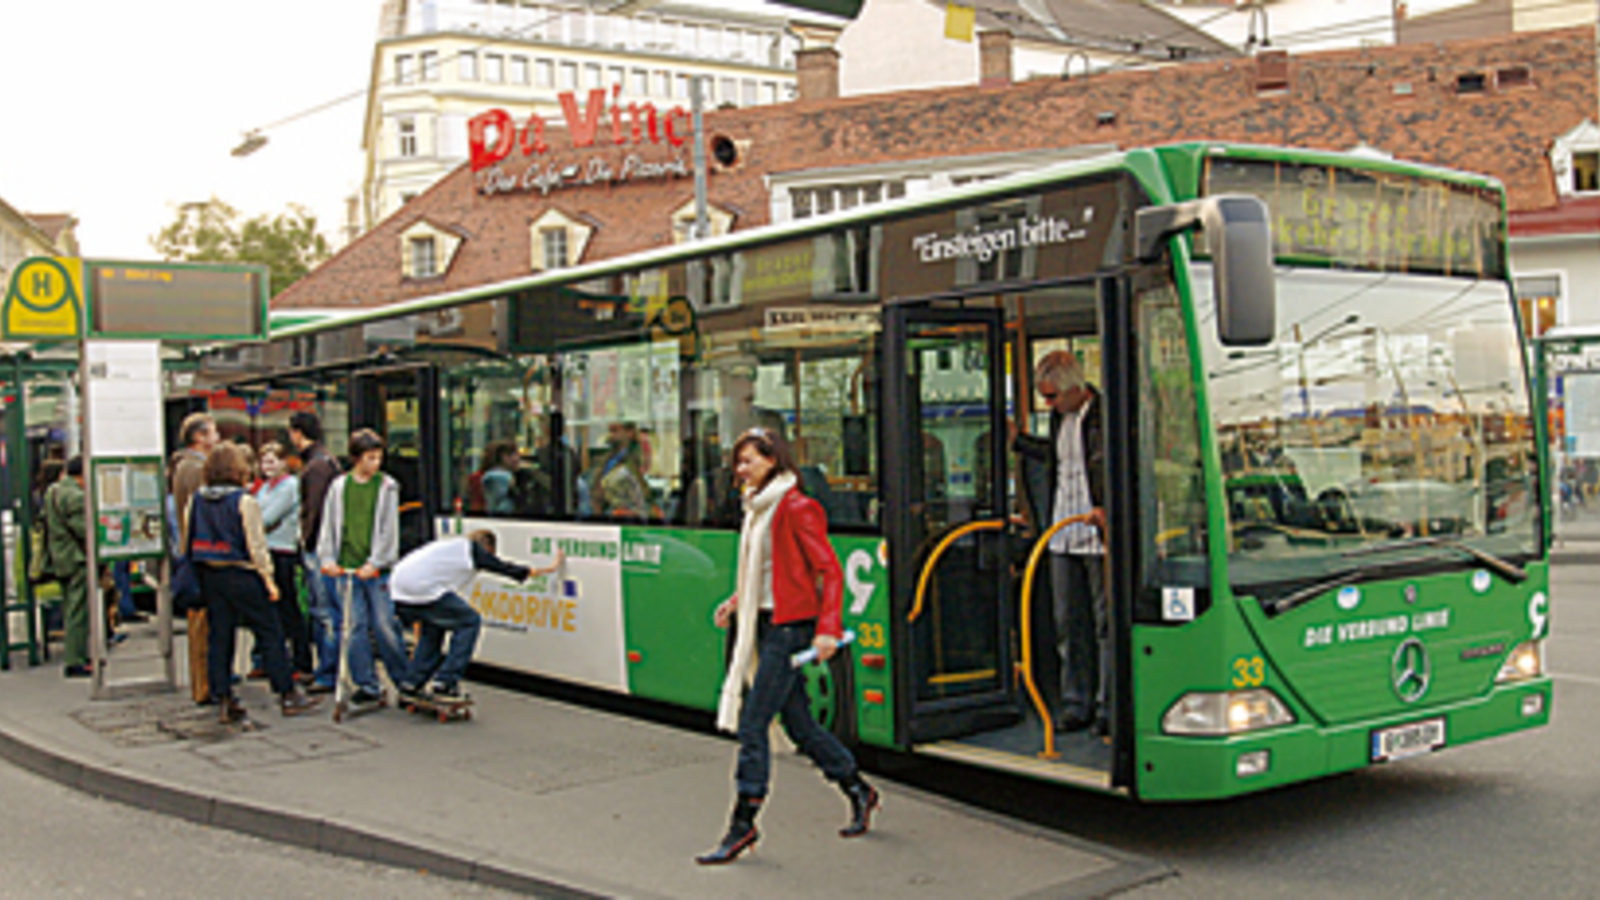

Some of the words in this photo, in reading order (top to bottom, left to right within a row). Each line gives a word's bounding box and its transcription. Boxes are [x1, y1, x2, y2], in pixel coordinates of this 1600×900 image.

[467, 108, 549, 172] Da
[557, 83, 695, 148] Vinc
[32, 271, 53, 297] H
[530, 536, 552, 555] DIE
[556, 537, 618, 561] VERBUND
[623, 541, 662, 565] LINIE
[858, 622, 885, 648] 33
[1303, 625, 1333, 649] DIE
[1337, 614, 1409, 643] VERBUND
[1412, 608, 1450, 633] LINIE
[1232, 656, 1265, 688] 33
